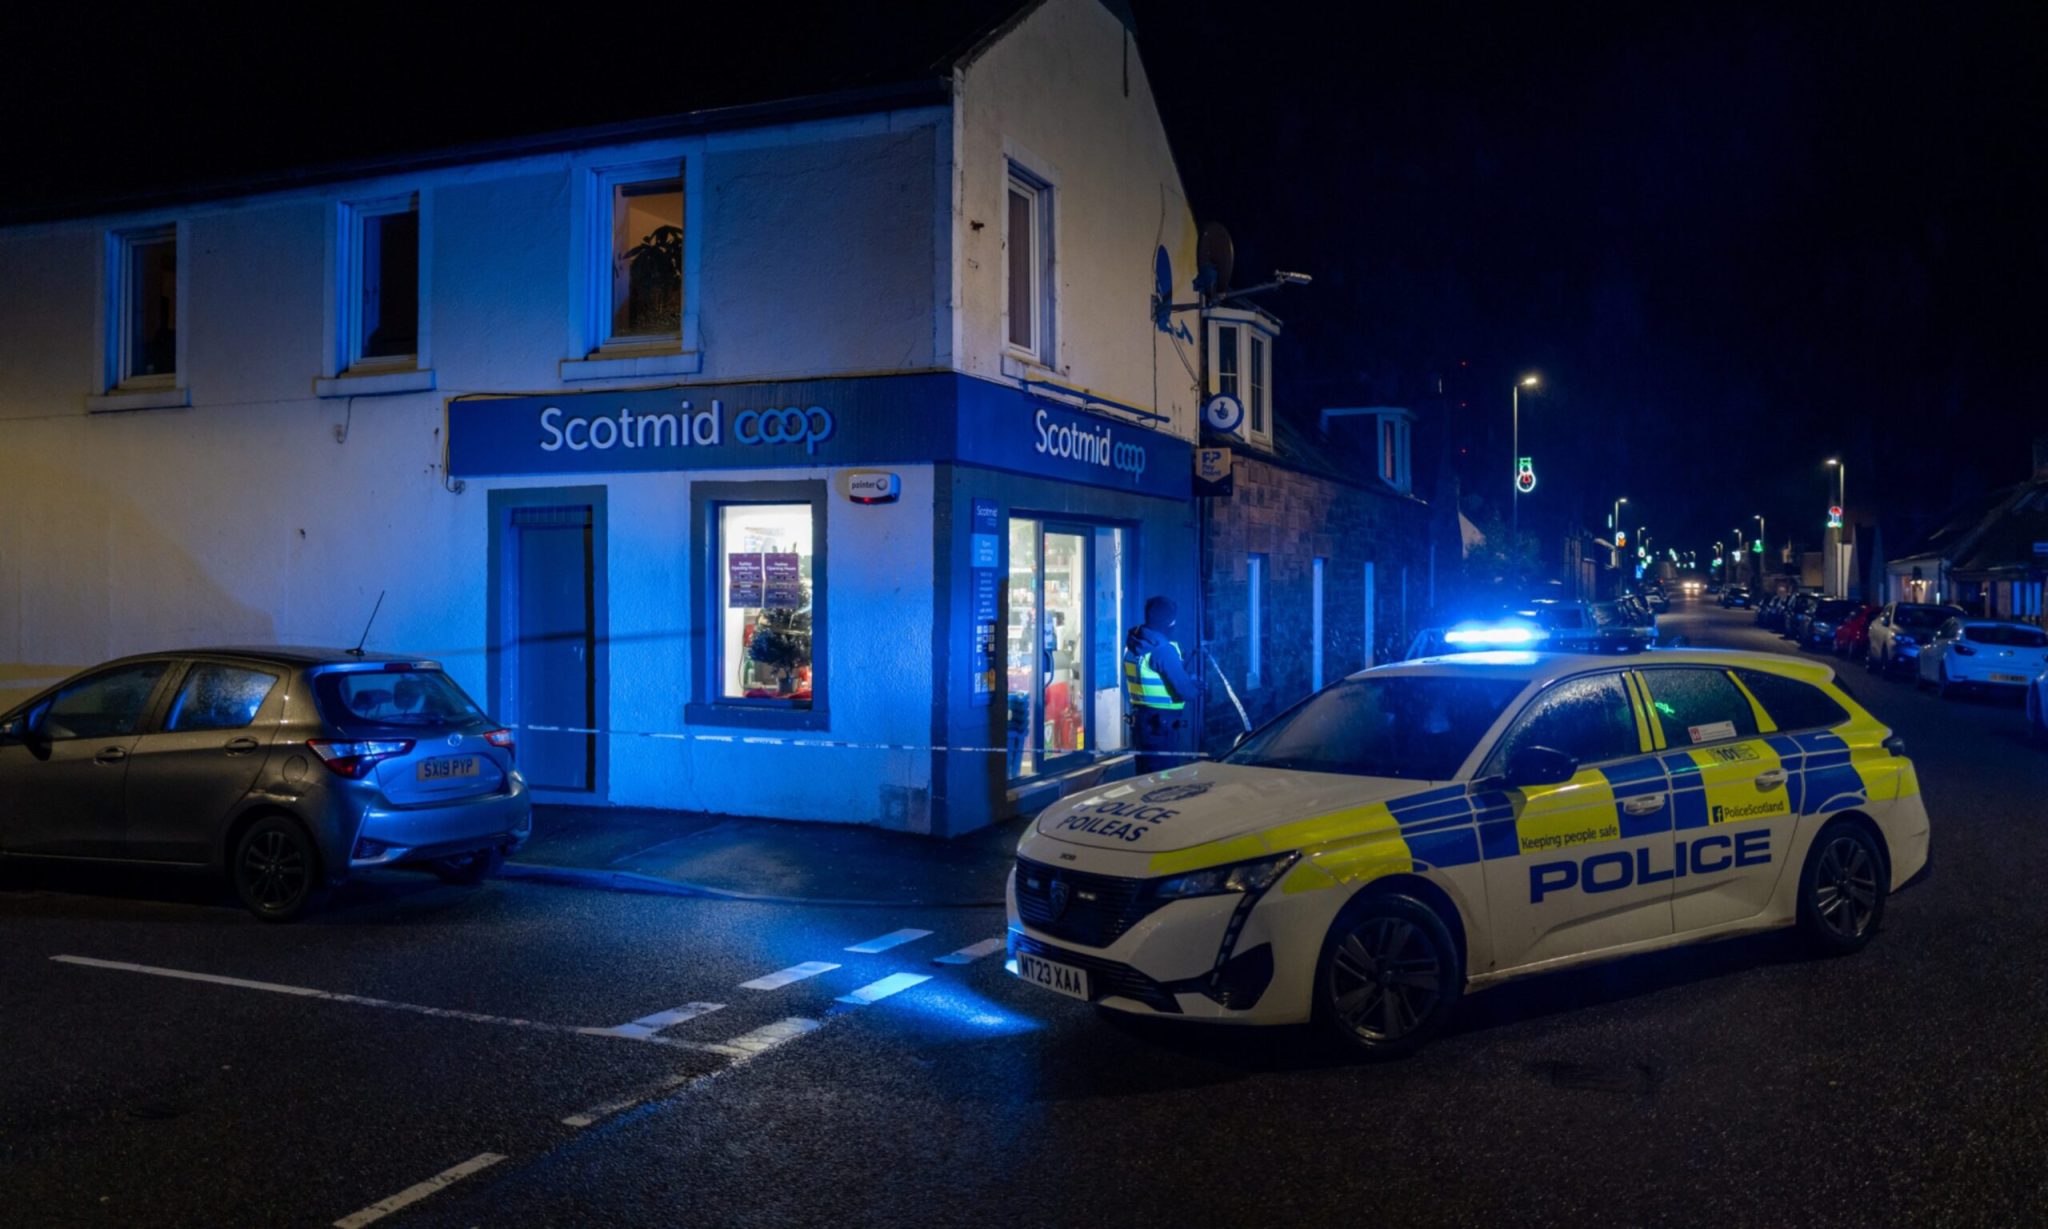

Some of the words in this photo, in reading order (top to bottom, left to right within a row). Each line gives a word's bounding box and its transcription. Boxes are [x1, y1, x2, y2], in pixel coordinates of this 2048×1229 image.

[540, 399, 720, 451] Scotmid
[734, 405, 833, 455] coop
[1035, 409, 1111, 467] Scotmid
[1113, 441, 1146, 484] coop
[976, 505, 998, 517] Scotmid
[424, 759, 450, 778] SX19
[452, 758, 473, 775] PYP
[1724, 801, 1785, 818] PoliceScotland
[1056, 815, 1149, 842] POILEAS
[1521, 833, 1562, 850] Keeping
[1564, 827, 1597, 846] people
[1599, 824, 1618, 838] safe
[1529, 828, 1772, 904] POLICE
[1054, 965, 1082, 995] XAA
